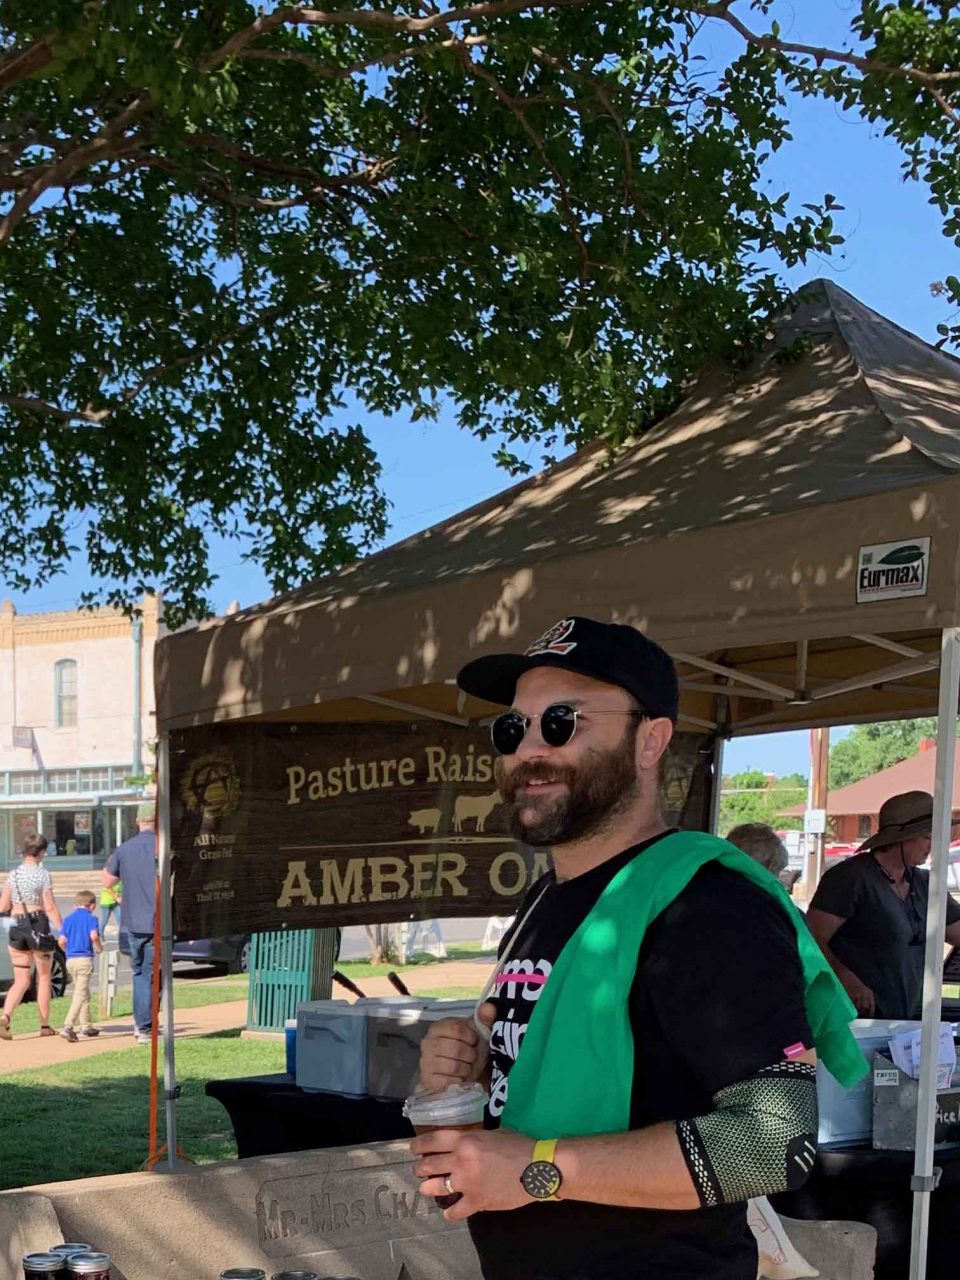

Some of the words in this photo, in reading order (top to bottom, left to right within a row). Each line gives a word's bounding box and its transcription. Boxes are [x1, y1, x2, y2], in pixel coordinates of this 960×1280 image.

[860, 563, 921, 589] Eurmax
[286, 756, 416, 805] Pasture
[277, 852, 469, 907] AMBER
